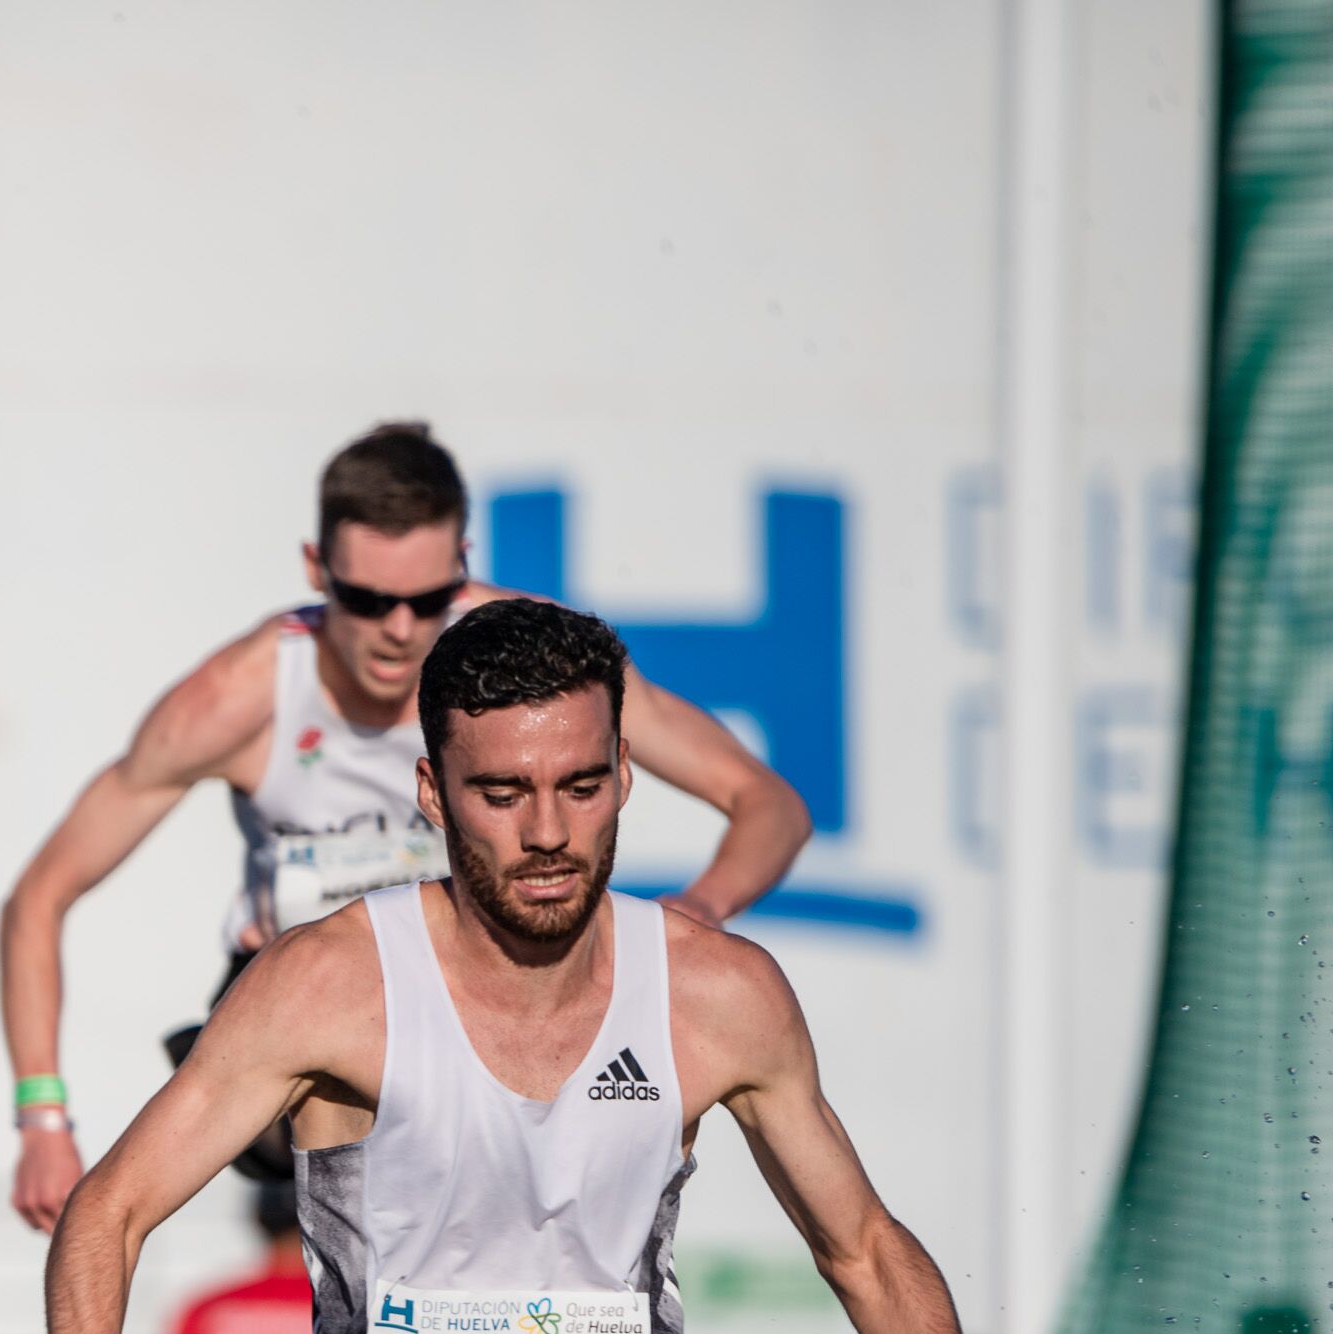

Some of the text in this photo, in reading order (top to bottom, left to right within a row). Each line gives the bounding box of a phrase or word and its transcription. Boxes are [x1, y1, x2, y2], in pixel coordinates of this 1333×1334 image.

[588, 1080, 661, 1102] adidas
[421, 1298, 521, 1316] DIPUTACIÓN
[565, 1301, 625, 1318] Que sea
[421, 1316, 511, 1332] DE HUELVA
[565, 1319, 644, 1334] de Huelva
